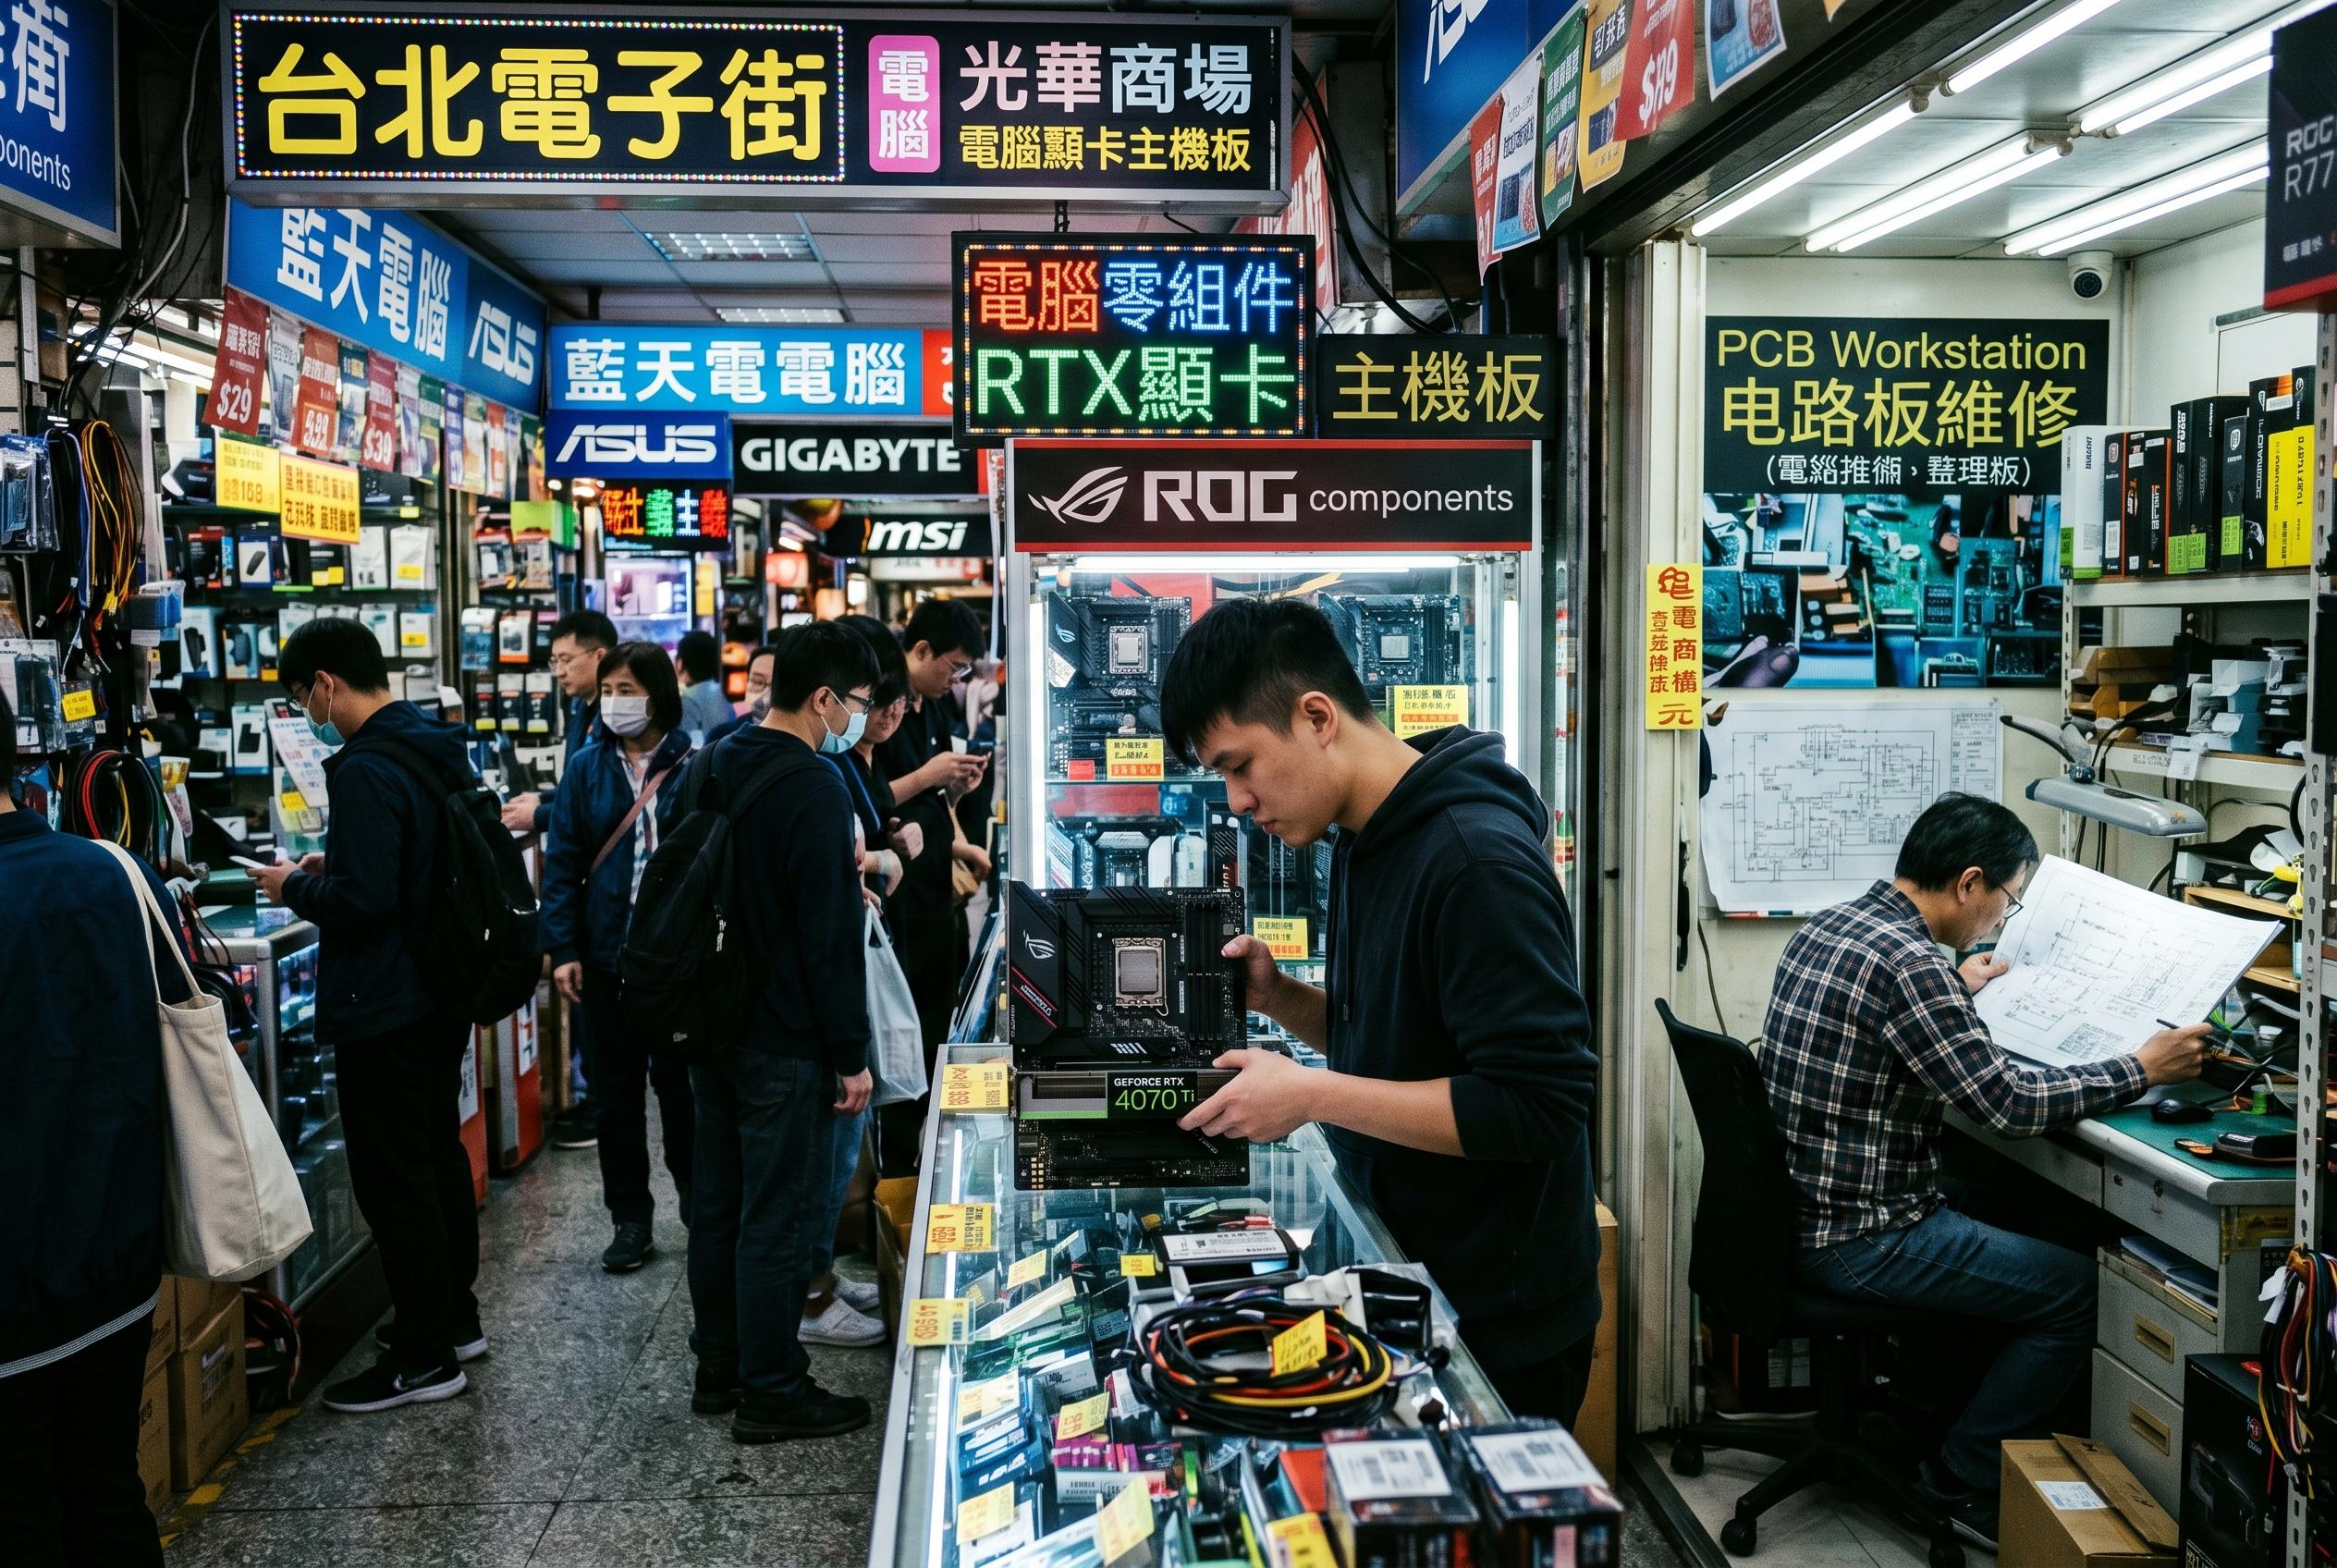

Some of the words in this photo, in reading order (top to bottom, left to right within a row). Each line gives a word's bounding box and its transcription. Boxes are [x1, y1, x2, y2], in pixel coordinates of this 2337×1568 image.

[258, 43, 827, 161] 台北電子街
[878, 50, 929, 158] 電腦
[960, 41, 1252, 115] 光華商場
[973, 260, 1293, 333] 電腦零組件
[468, 300, 537, 386] ASUS
[564, 338, 906, 406] 藍天電電腦
[1718, 329, 1815, 368] PCB
[1830, 330, 2086, 370] Workstation
[1333, 350, 1545, 423] 主機板
[556, 424, 718, 463] ASUS
[740, 438, 961, 472] GIGABYTE
[1144, 471, 1298, 521] ROG
[1309, 482, 1514, 519] components
[867, 521, 969, 551] msi
[1113, 1077, 1162, 1086] GEFORCE
[1163, 1077, 1184, 1086] RTX
[1115, 1089, 1177, 1110] 4070
[1181, 1089, 1194, 1103] Ti
